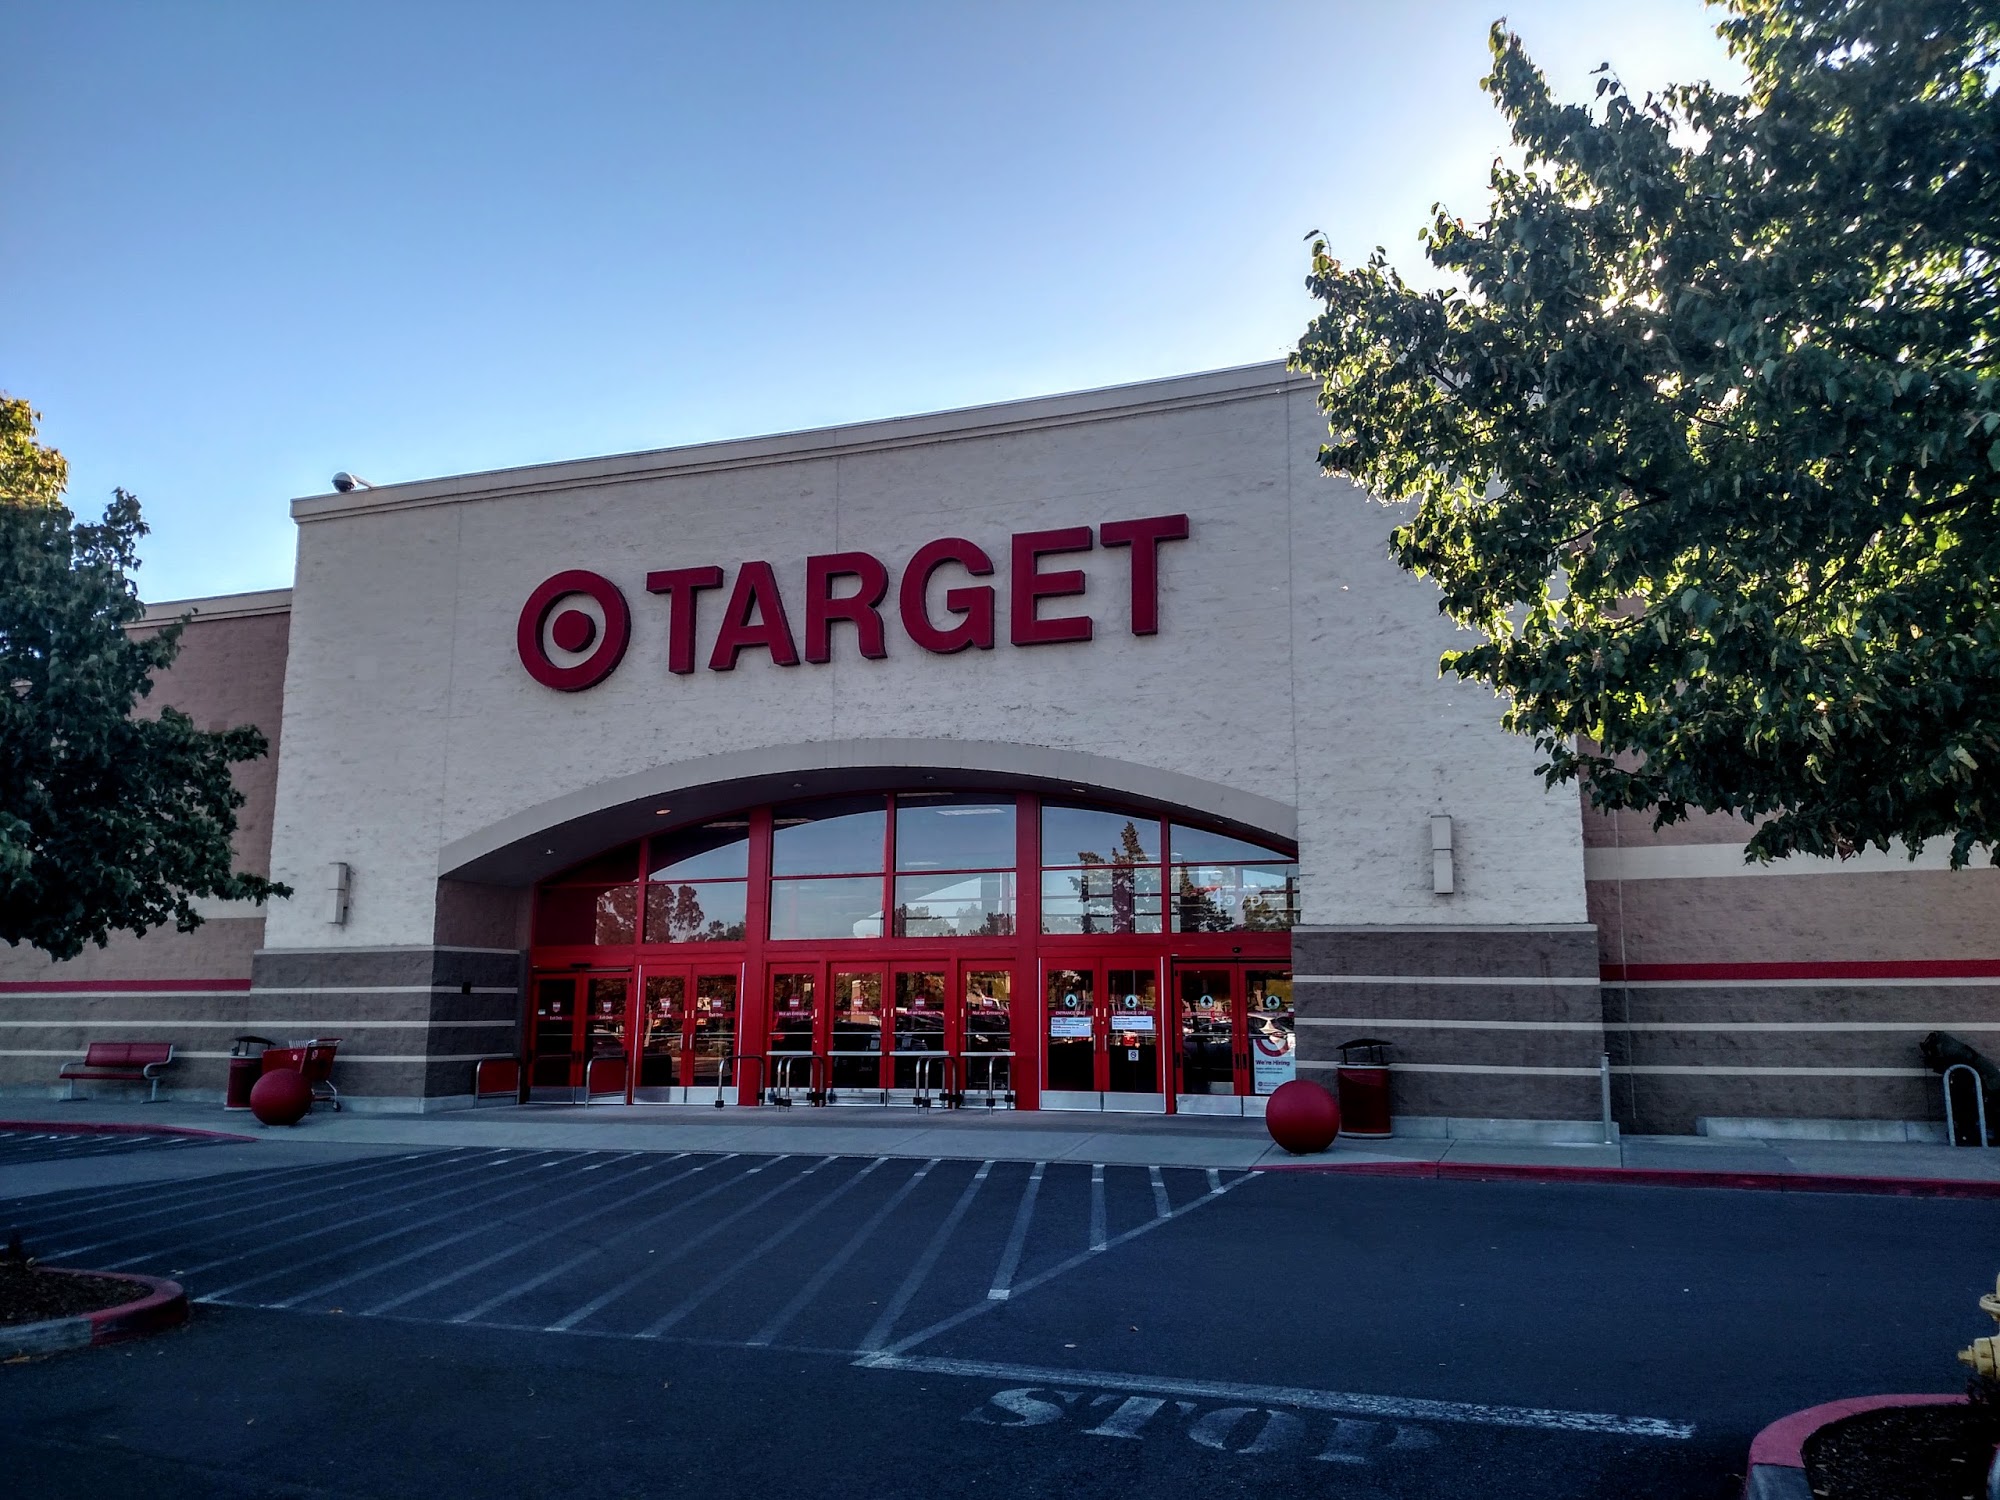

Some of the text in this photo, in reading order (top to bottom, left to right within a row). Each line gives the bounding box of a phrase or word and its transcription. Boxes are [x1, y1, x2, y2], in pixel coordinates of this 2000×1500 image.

[646, 514, 1189, 675] TARGET
[1210, 887, 1263, 907] 4575
[960, 1387, 1440, 1464] STOP
